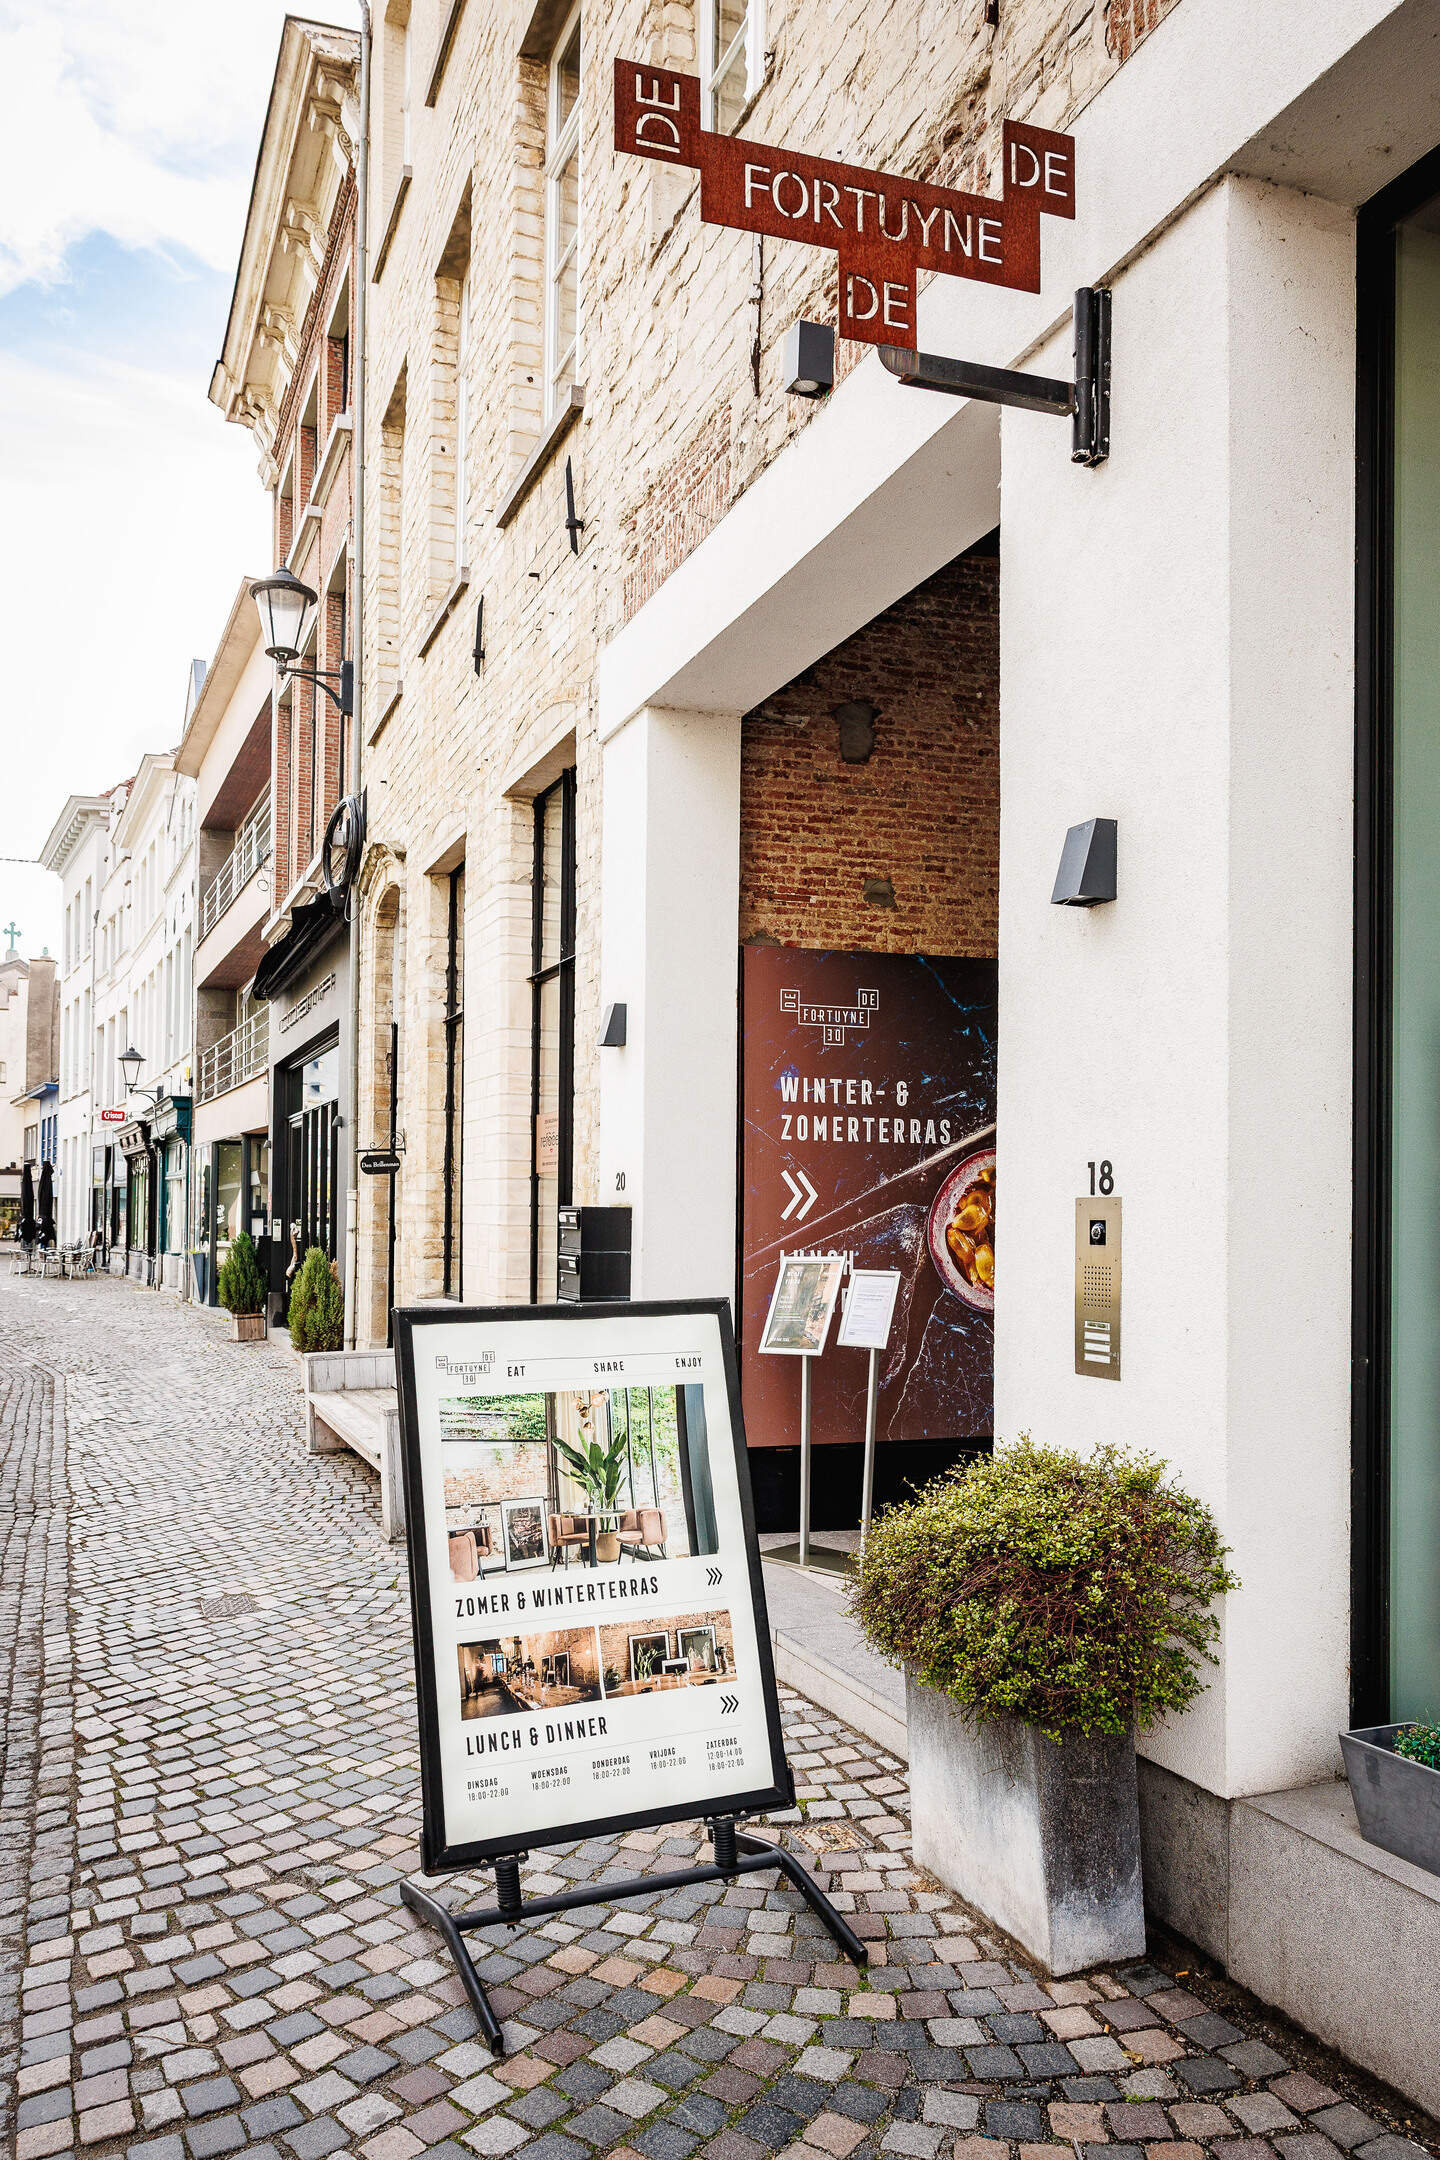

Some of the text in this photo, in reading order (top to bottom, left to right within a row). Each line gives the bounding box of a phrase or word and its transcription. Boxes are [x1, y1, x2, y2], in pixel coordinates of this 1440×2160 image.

[635, 73, 681, 154] DE
[1010, 142, 1068, 197] DE
[744, 162, 1003, 265] FORTUYNE
[846, 272, 910, 330] DE
[784, 991, 797, 1009] DE
[861, 993, 876, 1007] DE
[803, 1008, 865, 1025] FORTUYNE
[780, 1076, 910, 1107] WINTER- &
[780, 1114, 951, 1145] ZOMERTERRAS
[615, 1171, 626, 1191] 20
[1087, 1159, 1115, 1196] 18
[449, 1363, 488, 1374] FORTUYNE
[507, 1357, 703, 1378] EAT SHARE ENJOY
[455, 1576, 659, 1618] ZOMER & WINTERTERRAS
[466, 1716, 608, 1756] LUNCH & DINNER
[706, 1737, 738, 1750] ZATERDAG
[591, 1755, 631, 1770] DONDERDAG
[649, 1746, 676, 1759] VRIJDAG
[530, 1765, 569, 1780] WOENSDAG
[467, 1777, 499, 1790] DINSDAG
[468, 1787, 509, 1802] 18:00-22:00
